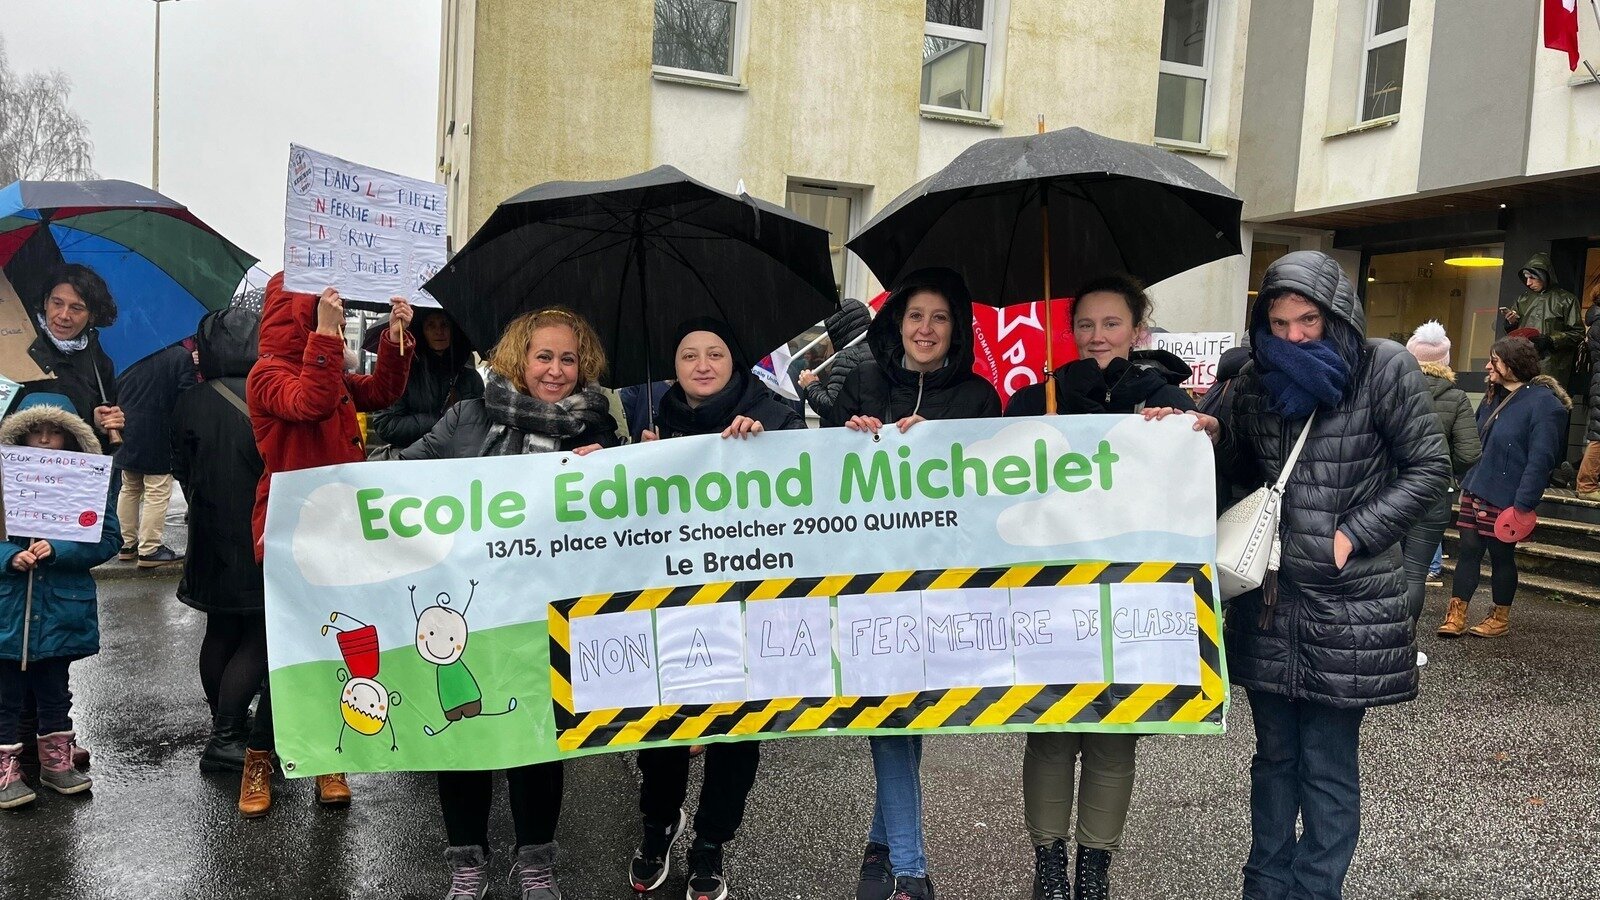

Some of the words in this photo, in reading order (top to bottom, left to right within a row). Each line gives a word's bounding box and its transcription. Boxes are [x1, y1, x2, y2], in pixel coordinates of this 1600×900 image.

[324, 167, 360, 193] DANS
[330, 197, 370, 222] FERME
[405, 218, 443, 236] CLASSE
[339, 222, 382, 249] GRAVE
[1002, 339, 1038, 397] PC
[1, 452, 31, 463] VEUX
[39, 455, 87, 468] GARDER
[15, 472, 64, 485] CLASSE
[355, 478, 527, 542] Ecole
[553, 451, 814, 523] Edmond
[838, 438, 1120, 504] Michelet
[20, 488, 40, 500] ET
[485, 537, 542, 559] 13/15,
[550, 532, 607, 558] place
[613, 527, 672, 548] Victor
[679, 519, 787, 542] Schoelcher
[792, 514, 858, 536] 29000
[863, 509, 959, 533] QUIMPER
[665, 554, 693, 577] Le
[703, 547, 794, 574] Braden
[578, 632, 651, 683] NON
[684, 627, 713, 669] A
[760, 618, 817, 658] LA
[850, 608, 1054, 657] FERMETURE
[1073, 608, 1100, 642] DE
[1112, 606, 1199, 640] CLASSE
